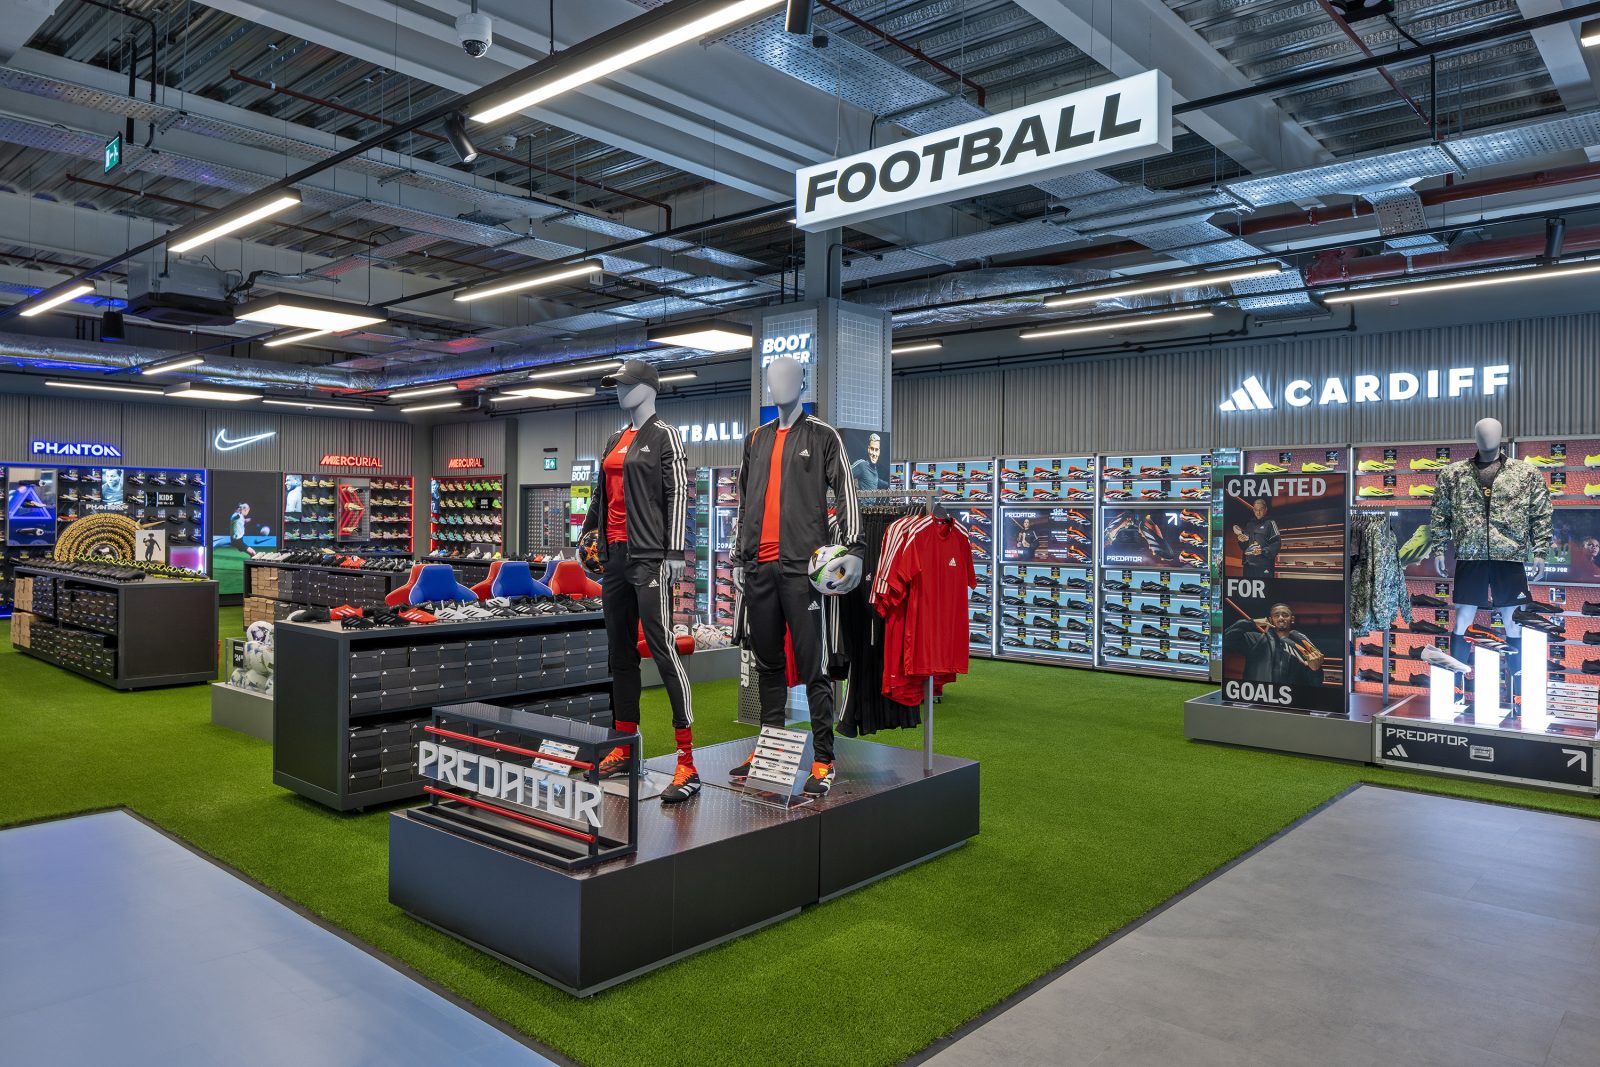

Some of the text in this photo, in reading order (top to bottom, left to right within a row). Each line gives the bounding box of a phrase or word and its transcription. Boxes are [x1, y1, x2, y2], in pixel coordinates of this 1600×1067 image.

[803, 93, 1143, 213] FOOTBALL
[762, 333, 811, 354] BOOT
[761, 350, 811, 368] FIER
[1284, 364, 1511, 408] CARDIFF
[678, 421, 743, 443] TBALL
[33, 441, 121, 457] PHANTOM
[320, 455, 383, 468] MERCURIAL
[449, 458, 483, 469] MERCURIAL
[571, 471, 591, 481] BOOT
[1227, 477, 1327, 498] CRAFTED
[1106, 555, 1143, 563] PREDATOR
[1227, 579, 1266, 600] FOR
[1225, 680, 1293, 705] GOALS
[1386, 727, 1469, 748] PREDATOR
[418, 740, 603, 828] PREDATOR
